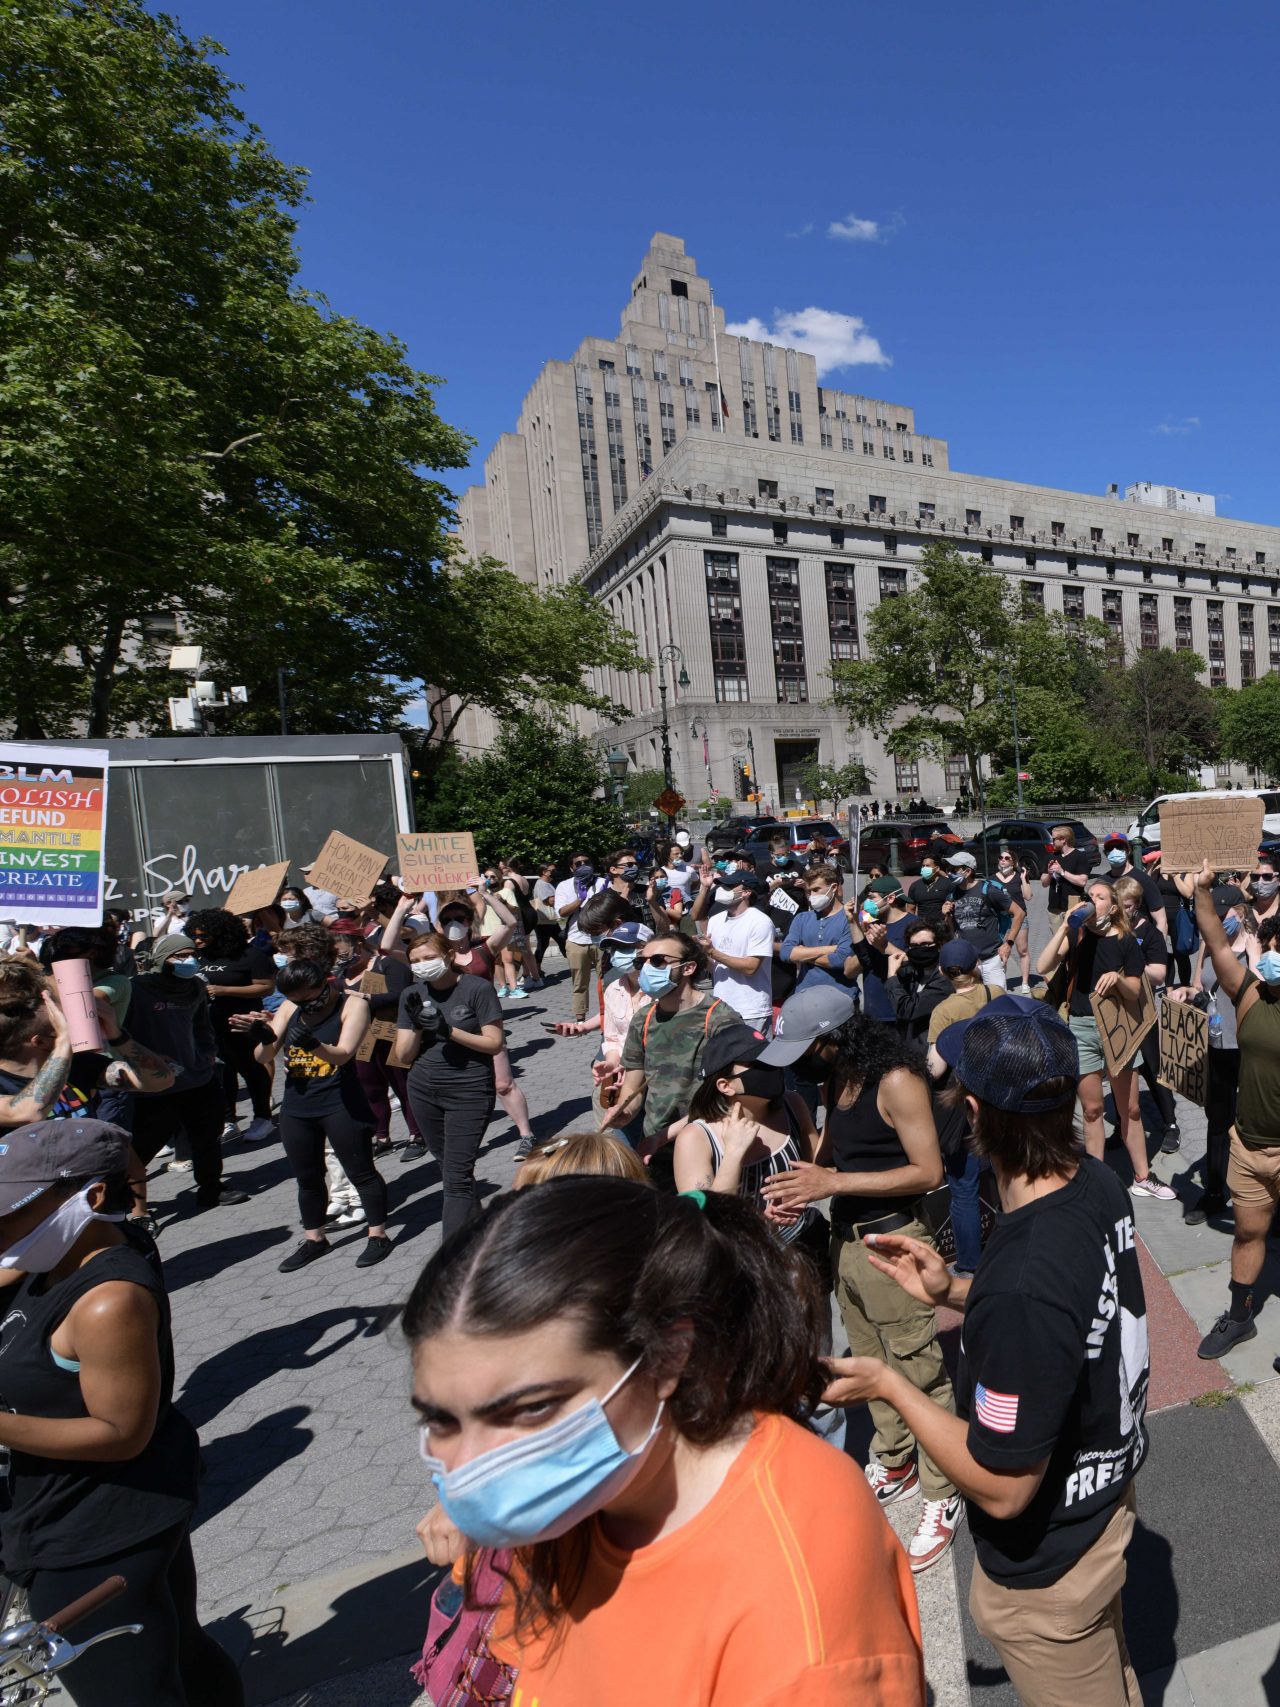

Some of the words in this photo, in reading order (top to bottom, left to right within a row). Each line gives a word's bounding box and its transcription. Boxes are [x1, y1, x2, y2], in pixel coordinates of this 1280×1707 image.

[326, 837, 351, 864] HOW
[354, 852, 382, 878] MANY
[400, 836, 465, 851] WHITE
[403, 853, 470, 867] SILENCE
[143, 844, 267, 898] Shar
[315, 872, 362, 898] FILMED?
[1160, 1001, 1206, 1048] BLACK
[1160, 1030, 1205, 1074] LIVES
[1160, 1057, 1204, 1103] MATTER
[1064, 1458, 1126, 1508] FREE
